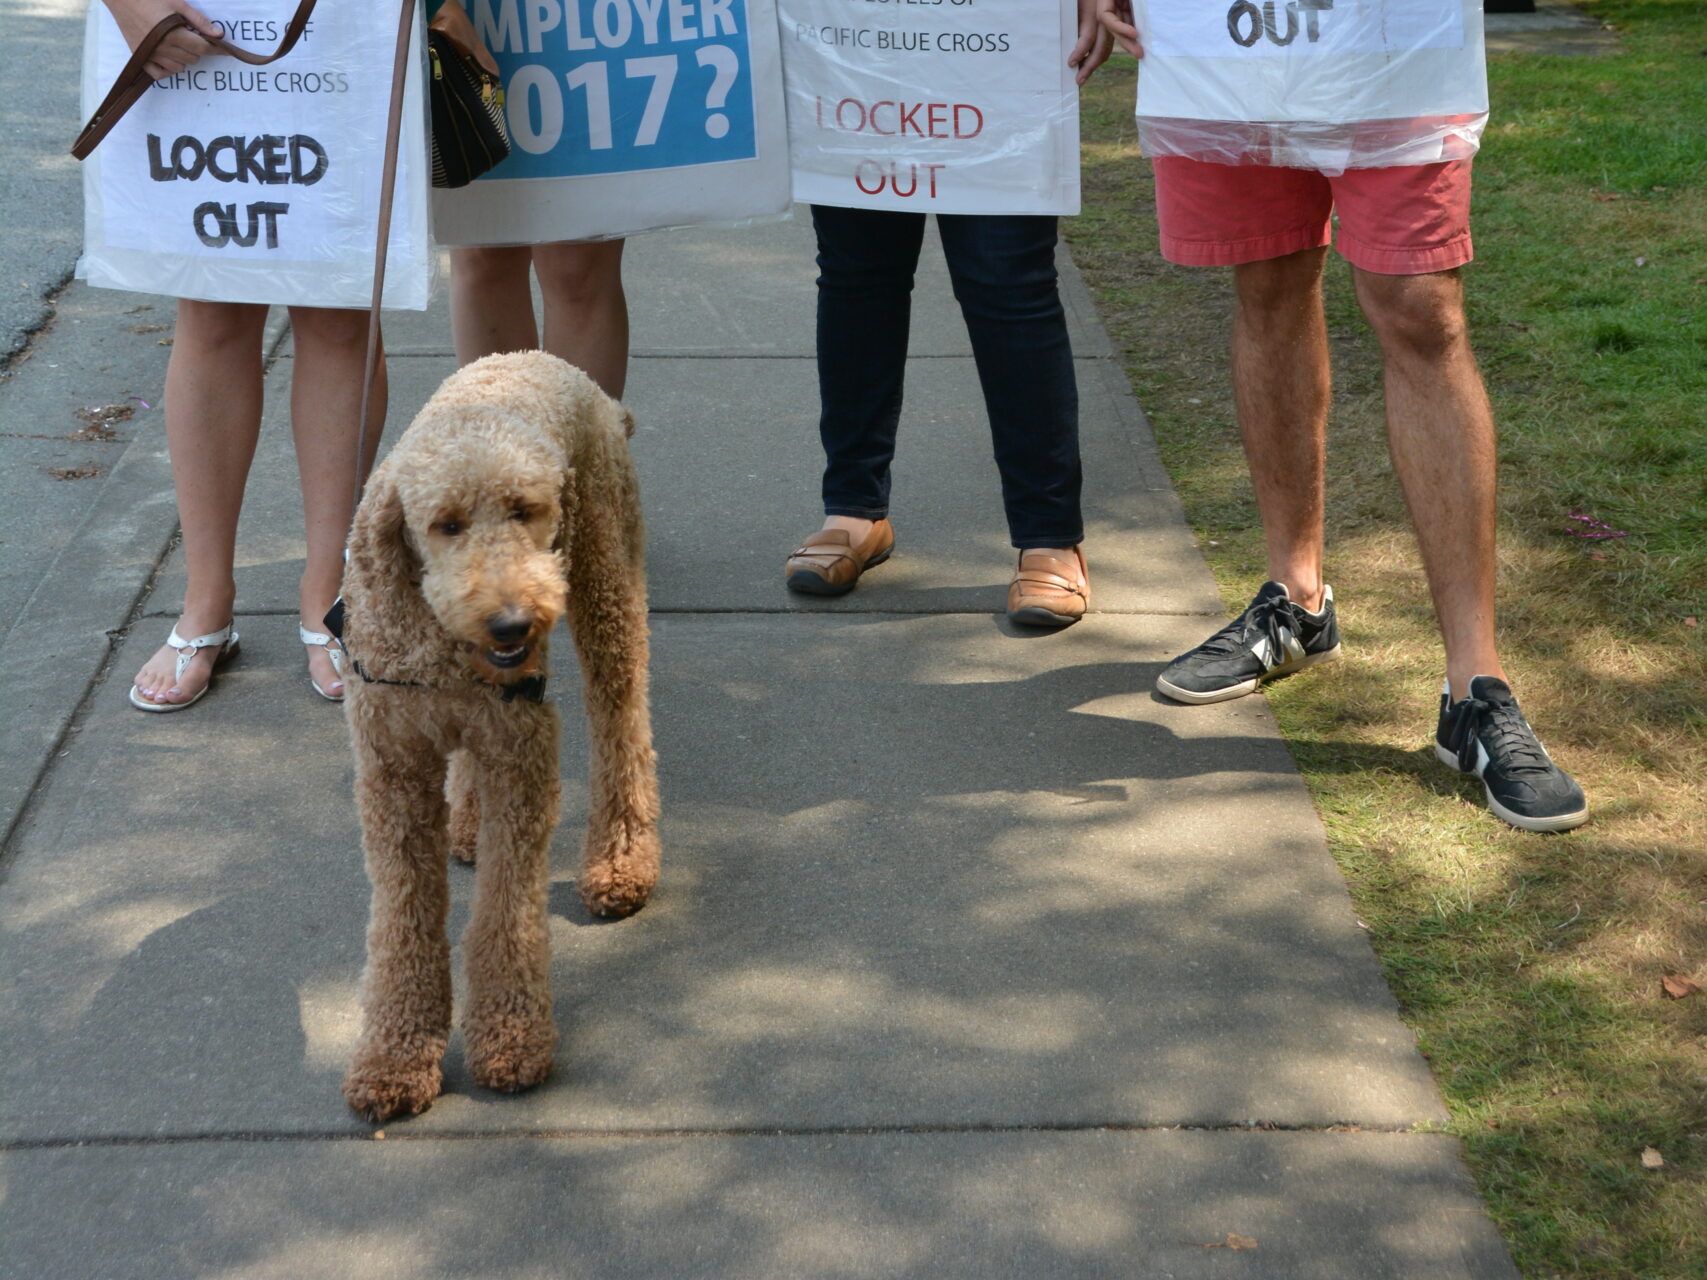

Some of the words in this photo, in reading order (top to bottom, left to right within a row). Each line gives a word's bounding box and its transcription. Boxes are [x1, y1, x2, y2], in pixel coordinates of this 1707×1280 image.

[796, 24, 872, 48] PACIFIC
[877, 31, 930, 51] BLUE
[937, 33, 1010, 52] CROSS
[214, 70, 268, 92] BLUE
[274, 72, 349, 93] CROSS
[506, 44, 740, 155] 017?
[816, 96, 984, 139] LOCKED
[147, 133, 329, 186] LOCKED
[855, 159, 946, 198] OUT
[193, 201, 289, 249] OUT
